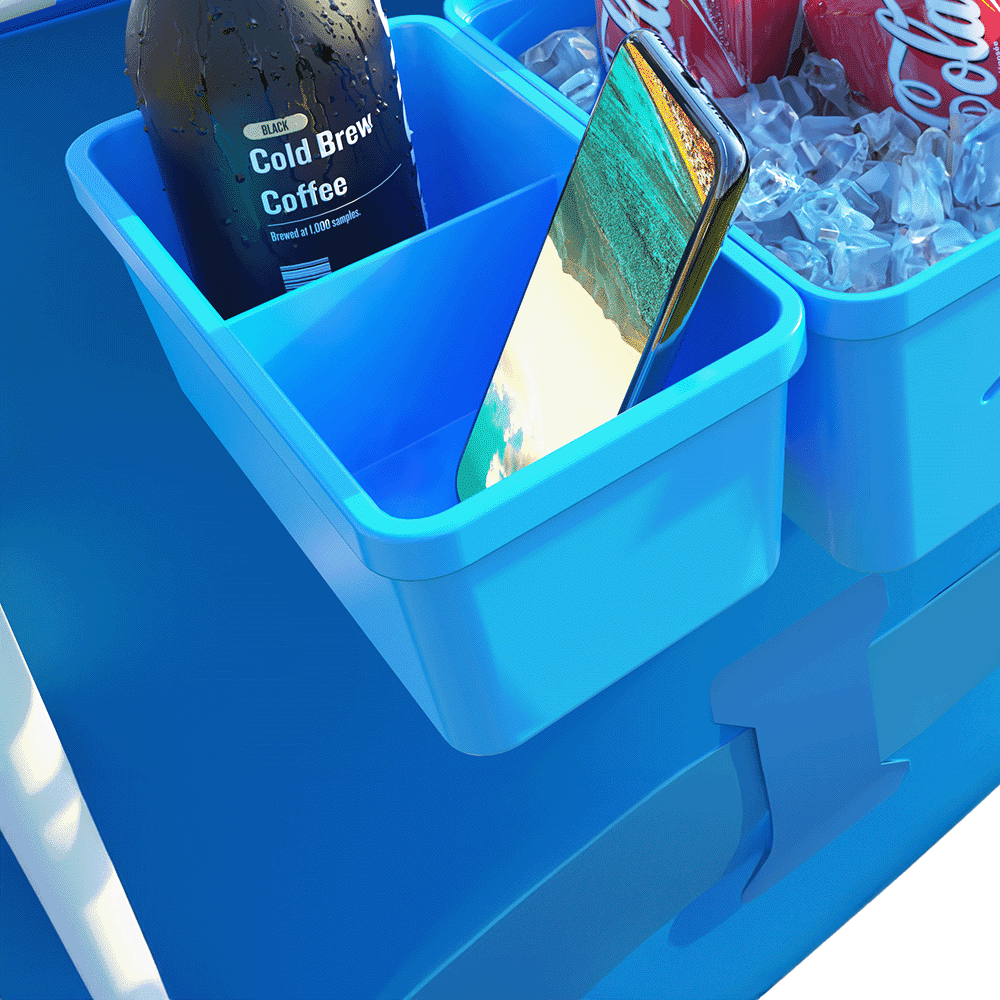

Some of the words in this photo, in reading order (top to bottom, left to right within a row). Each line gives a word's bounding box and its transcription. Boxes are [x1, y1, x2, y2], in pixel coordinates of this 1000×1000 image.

[249, 137, 313, 174] Cold
[316, 113, 374, 158] Brew
[261, 120, 290, 136] BLACK
[261, 176, 348, 215] Coffee
[270, 229, 300, 242] Brewed
[300, 225, 309, 237] at
[331, 208, 362, 228] samples.
